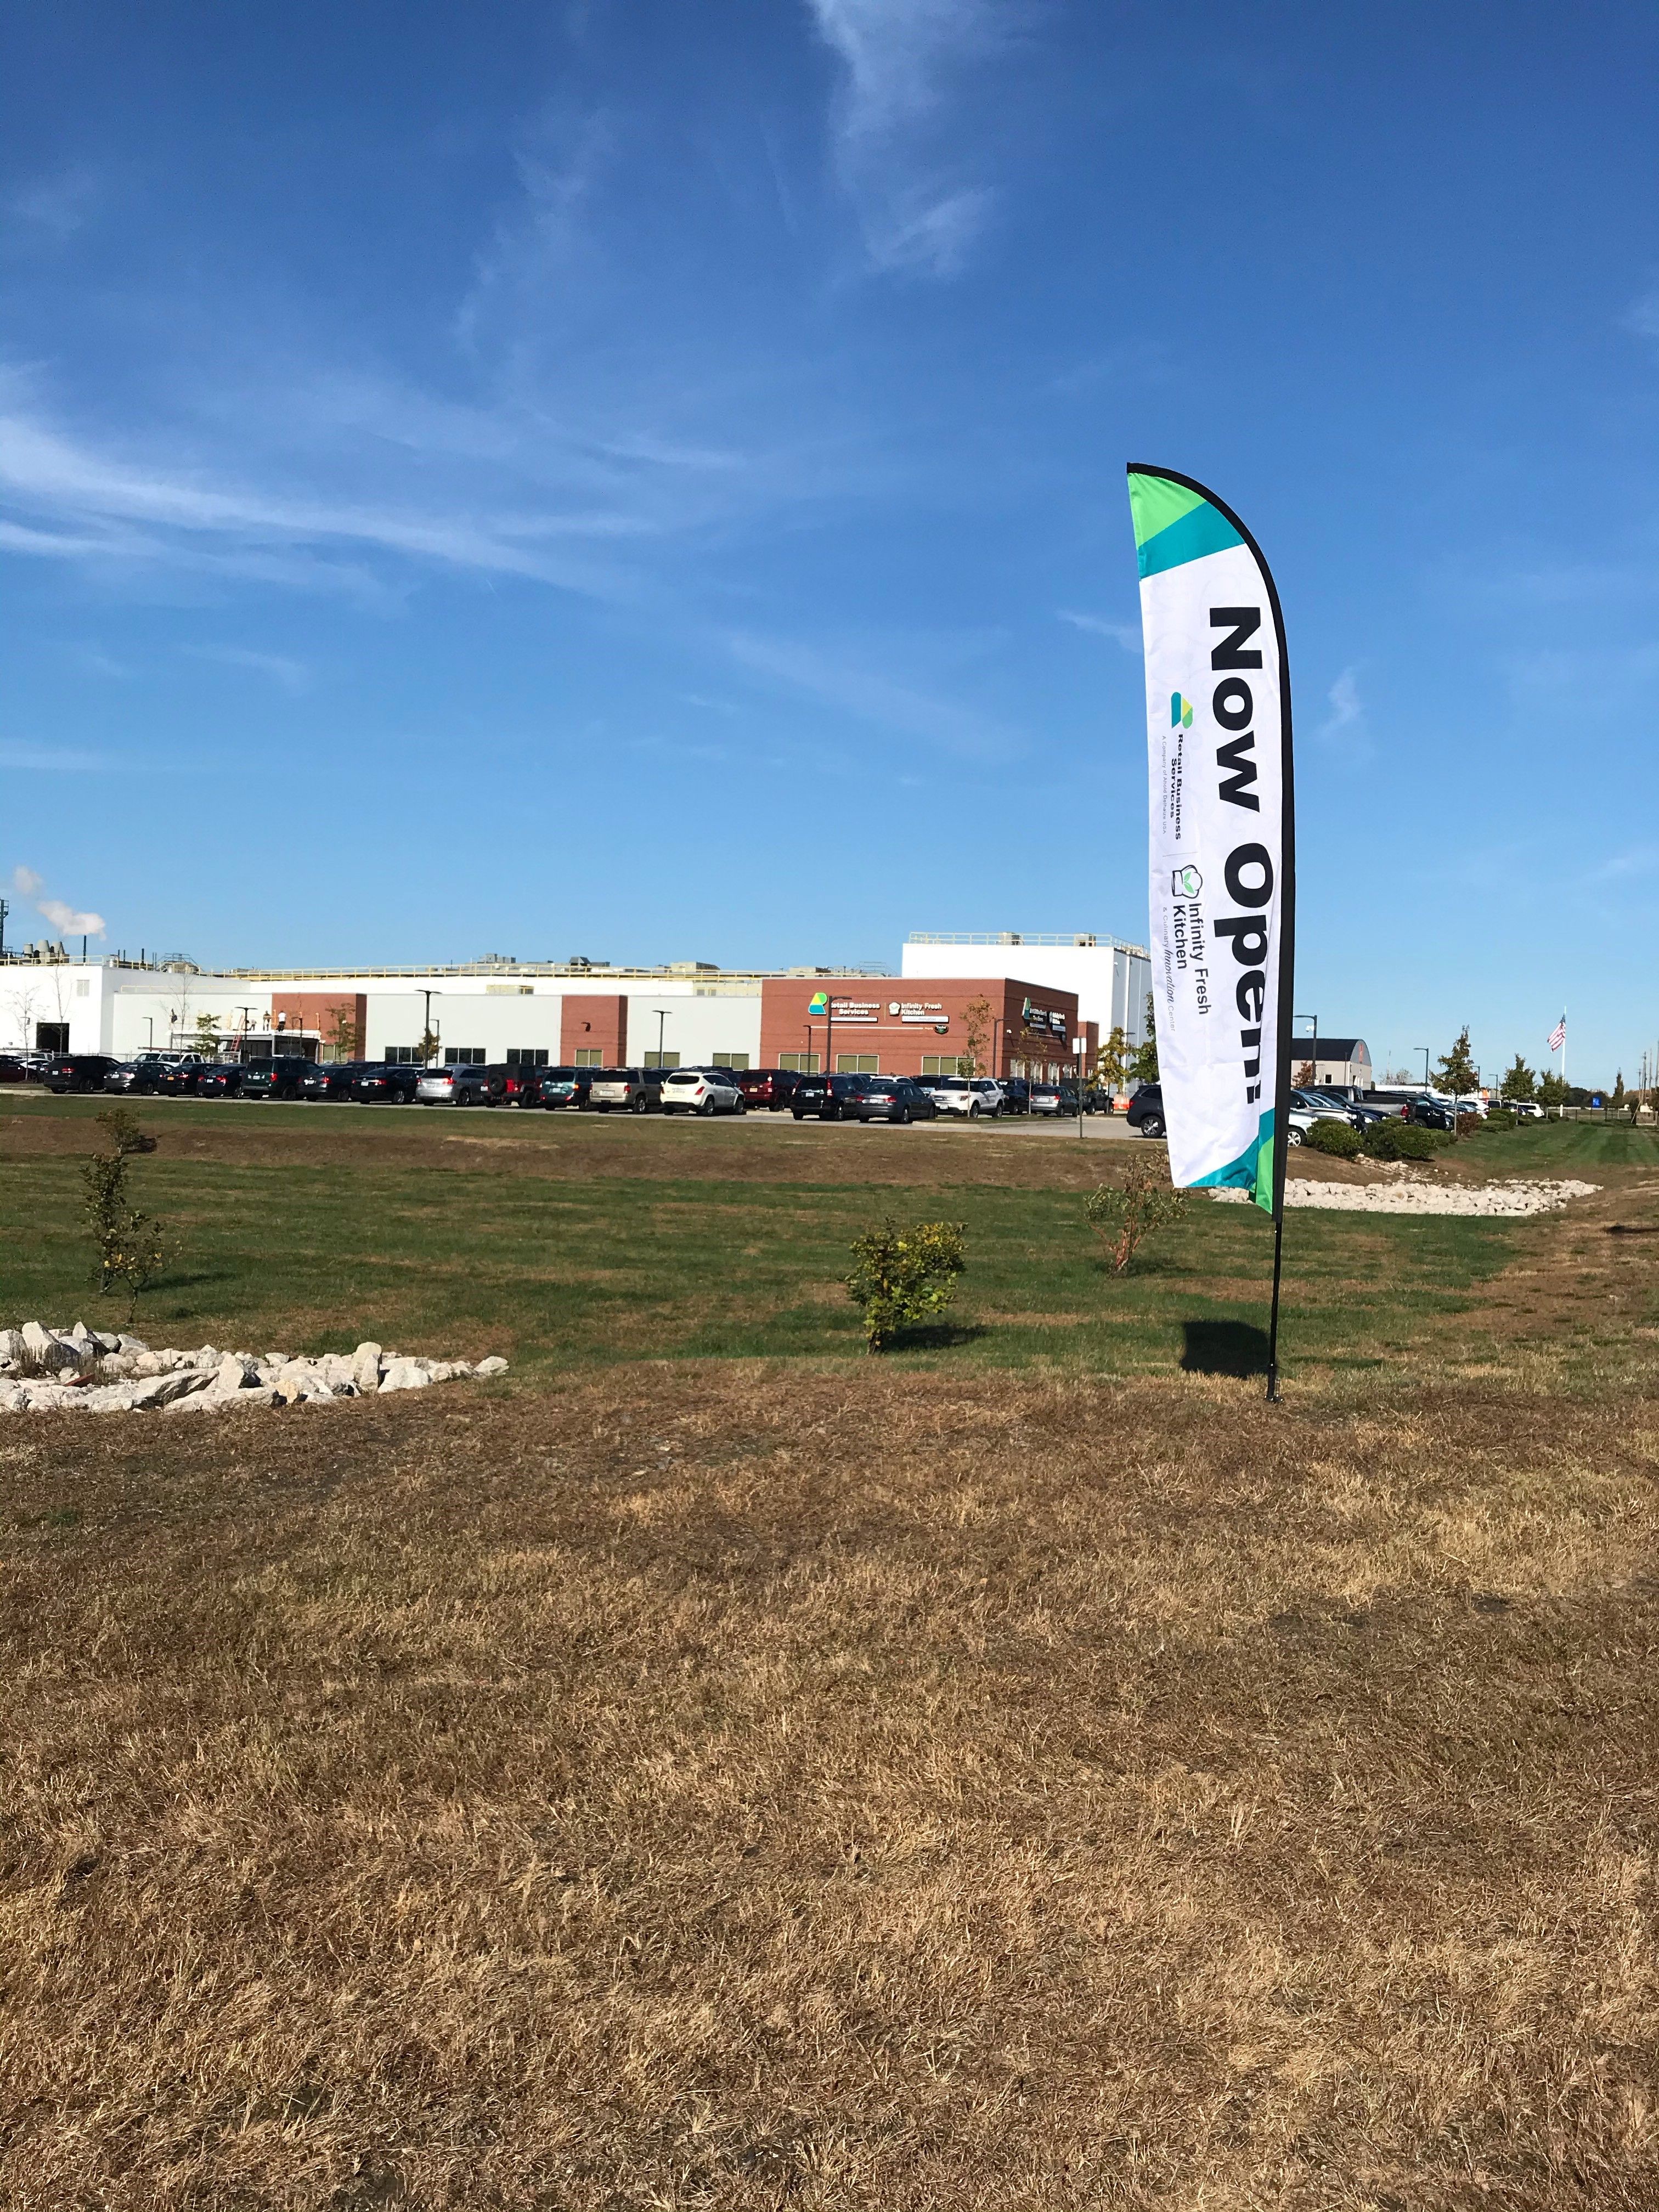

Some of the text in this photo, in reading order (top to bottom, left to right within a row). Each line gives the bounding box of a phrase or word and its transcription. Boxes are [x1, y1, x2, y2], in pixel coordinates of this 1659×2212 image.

[1210, 607, 1263, 813] Now
[1173, 905, 1188, 969] Kitchen
[1189, 903, 1212, 1014] Infinity Fresh
[1164, 949, 1176, 1003] Innovation
[1167, 1006, 1176, 1031] Center
